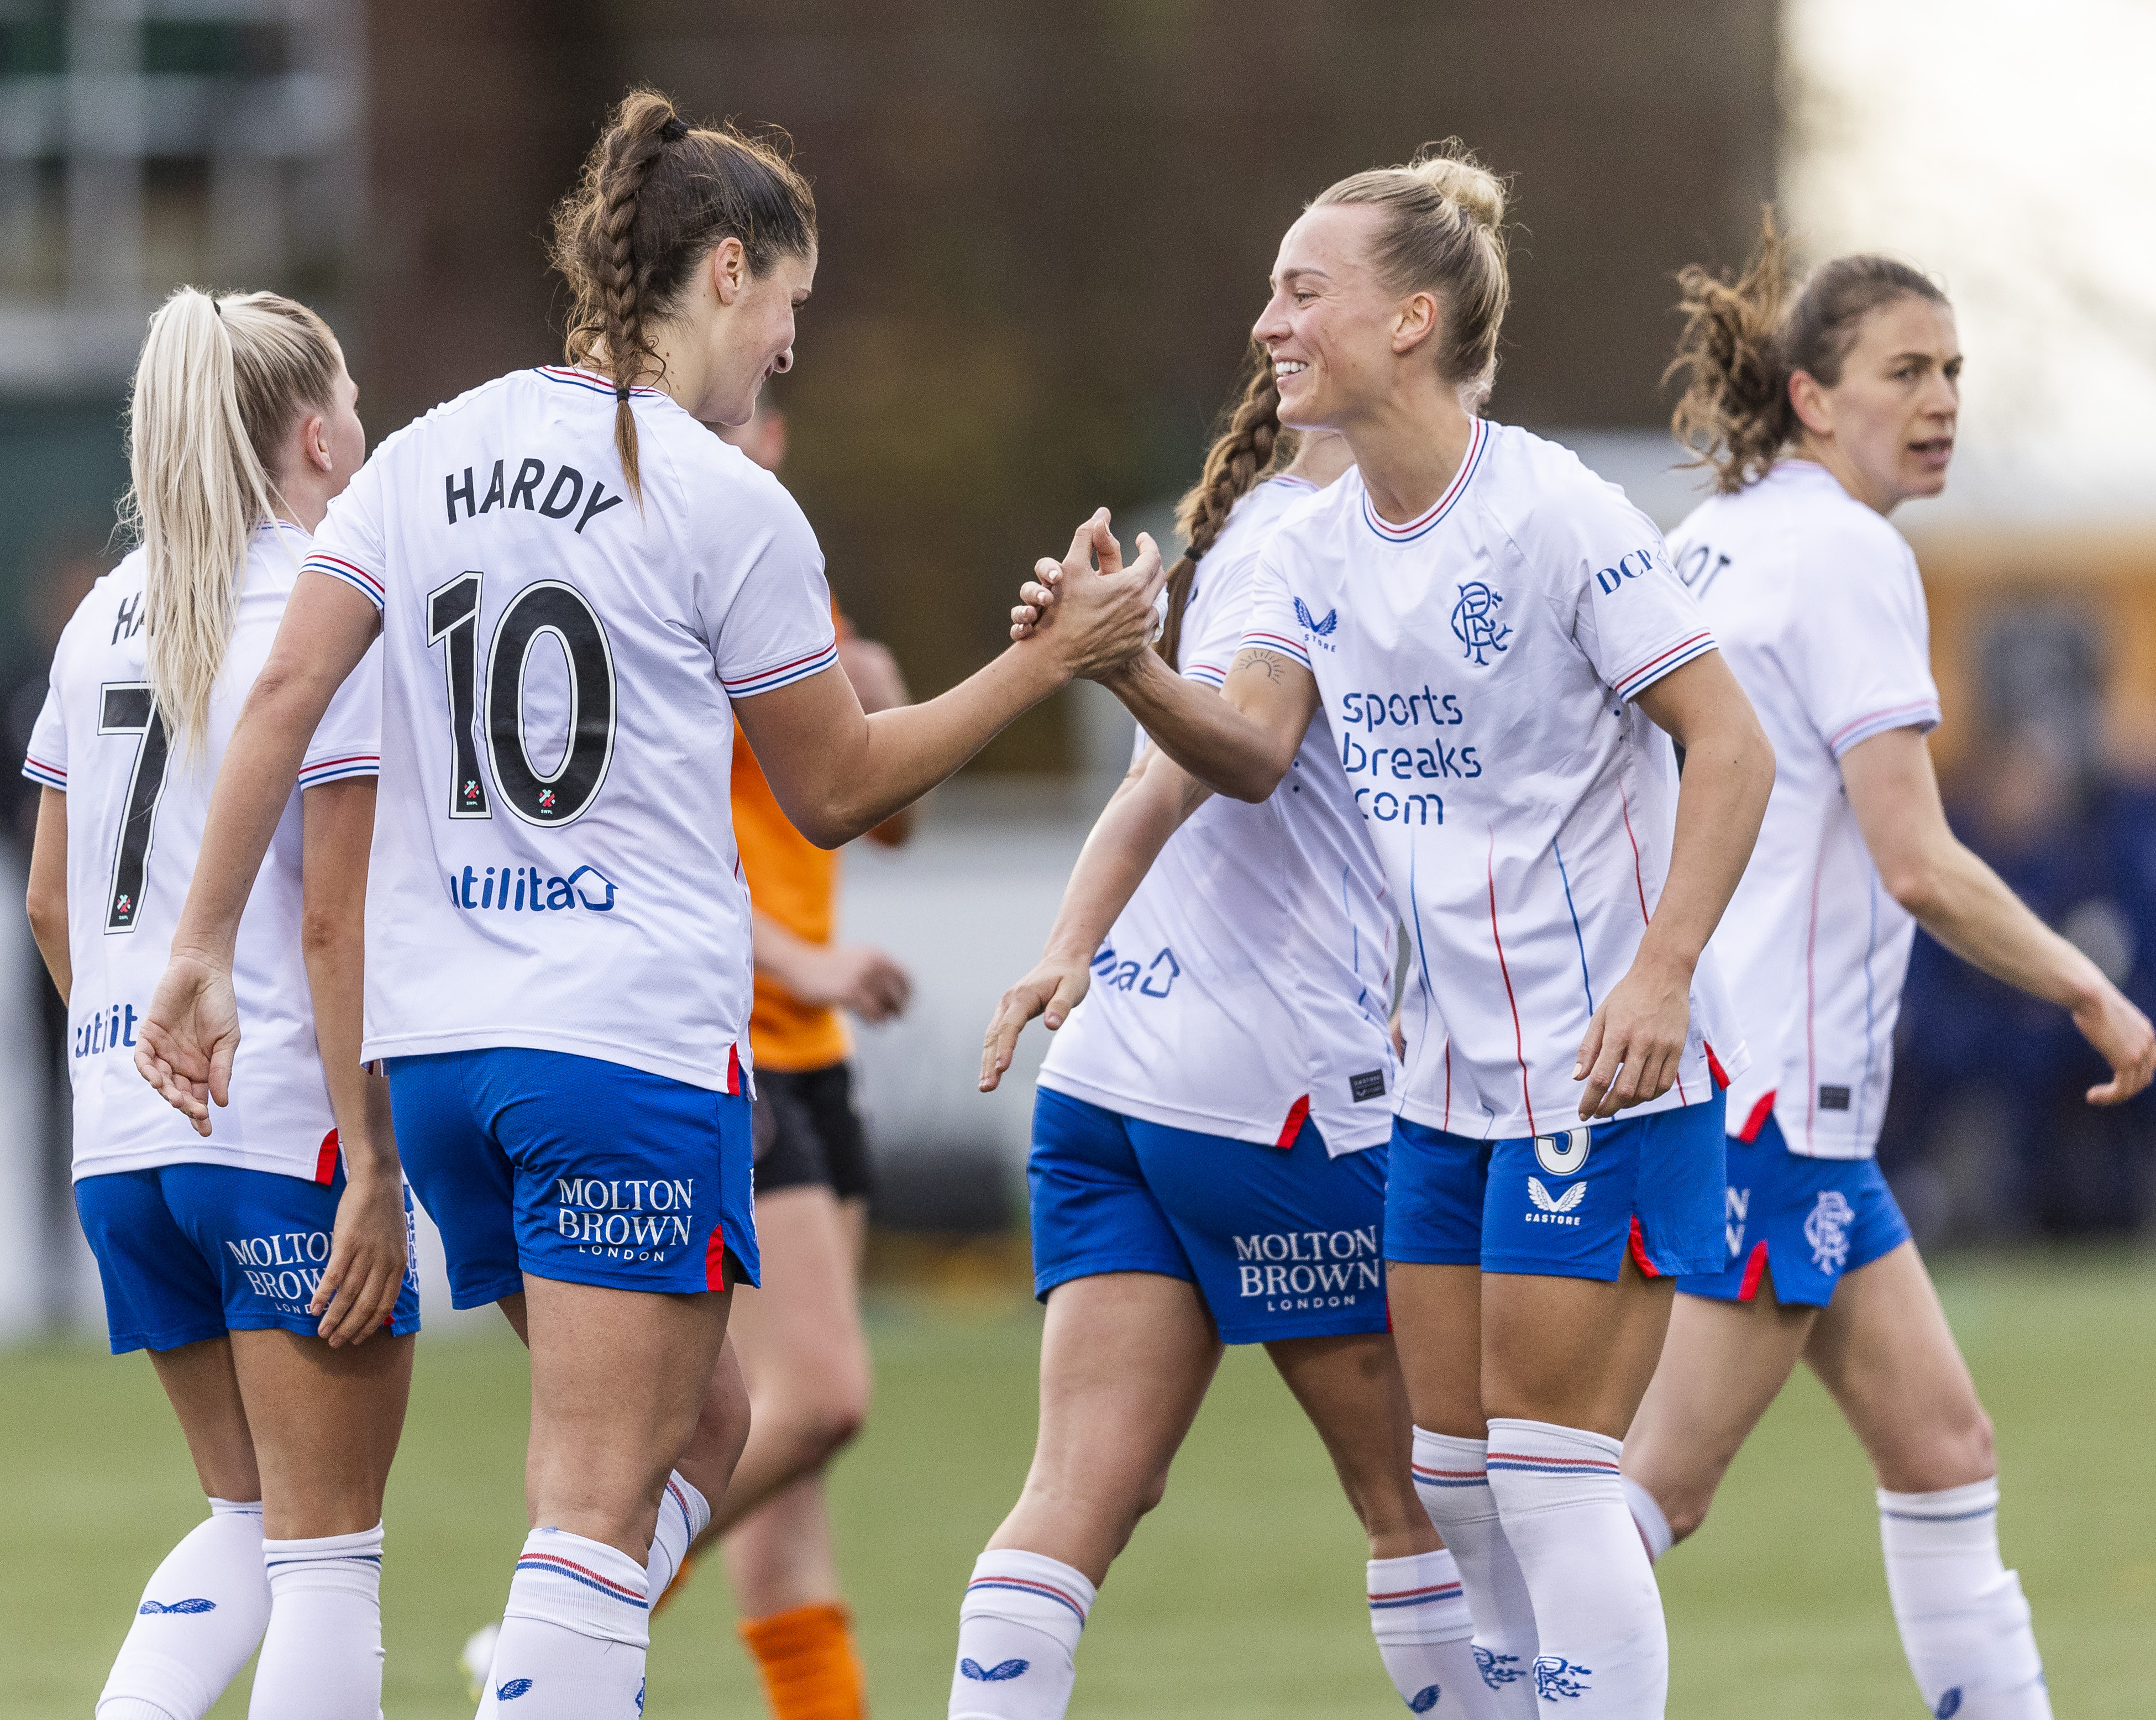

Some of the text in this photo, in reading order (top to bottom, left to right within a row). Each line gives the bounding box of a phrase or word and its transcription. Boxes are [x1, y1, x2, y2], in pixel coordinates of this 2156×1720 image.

[445, 458, 623, 534] HARDY
[1596, 549, 1654, 596] DCP
[111, 591, 155, 646] HA
[1304, 634, 1336, 652] STORE
[427, 571, 617, 827] 10
[1342, 685, 1462, 732] sports
[1343, 732, 1482, 779] breaks
[98, 681, 180, 935] 7
[555, 1178, 694, 1211] MOLTON
[559, 1208, 693, 1246] BROWN
[1525, 1213, 1581, 1226] CASTORE
[225, 1231, 334, 1267] MOLTO
[579, 1245, 664, 1262] LONDON
[1232, 1225, 1377, 1261] MOLTON
[243, 1267, 327, 1300] BROW
[1239, 1258, 1379, 1297] BROWN
[1267, 1294, 1356, 1312] LONDON
